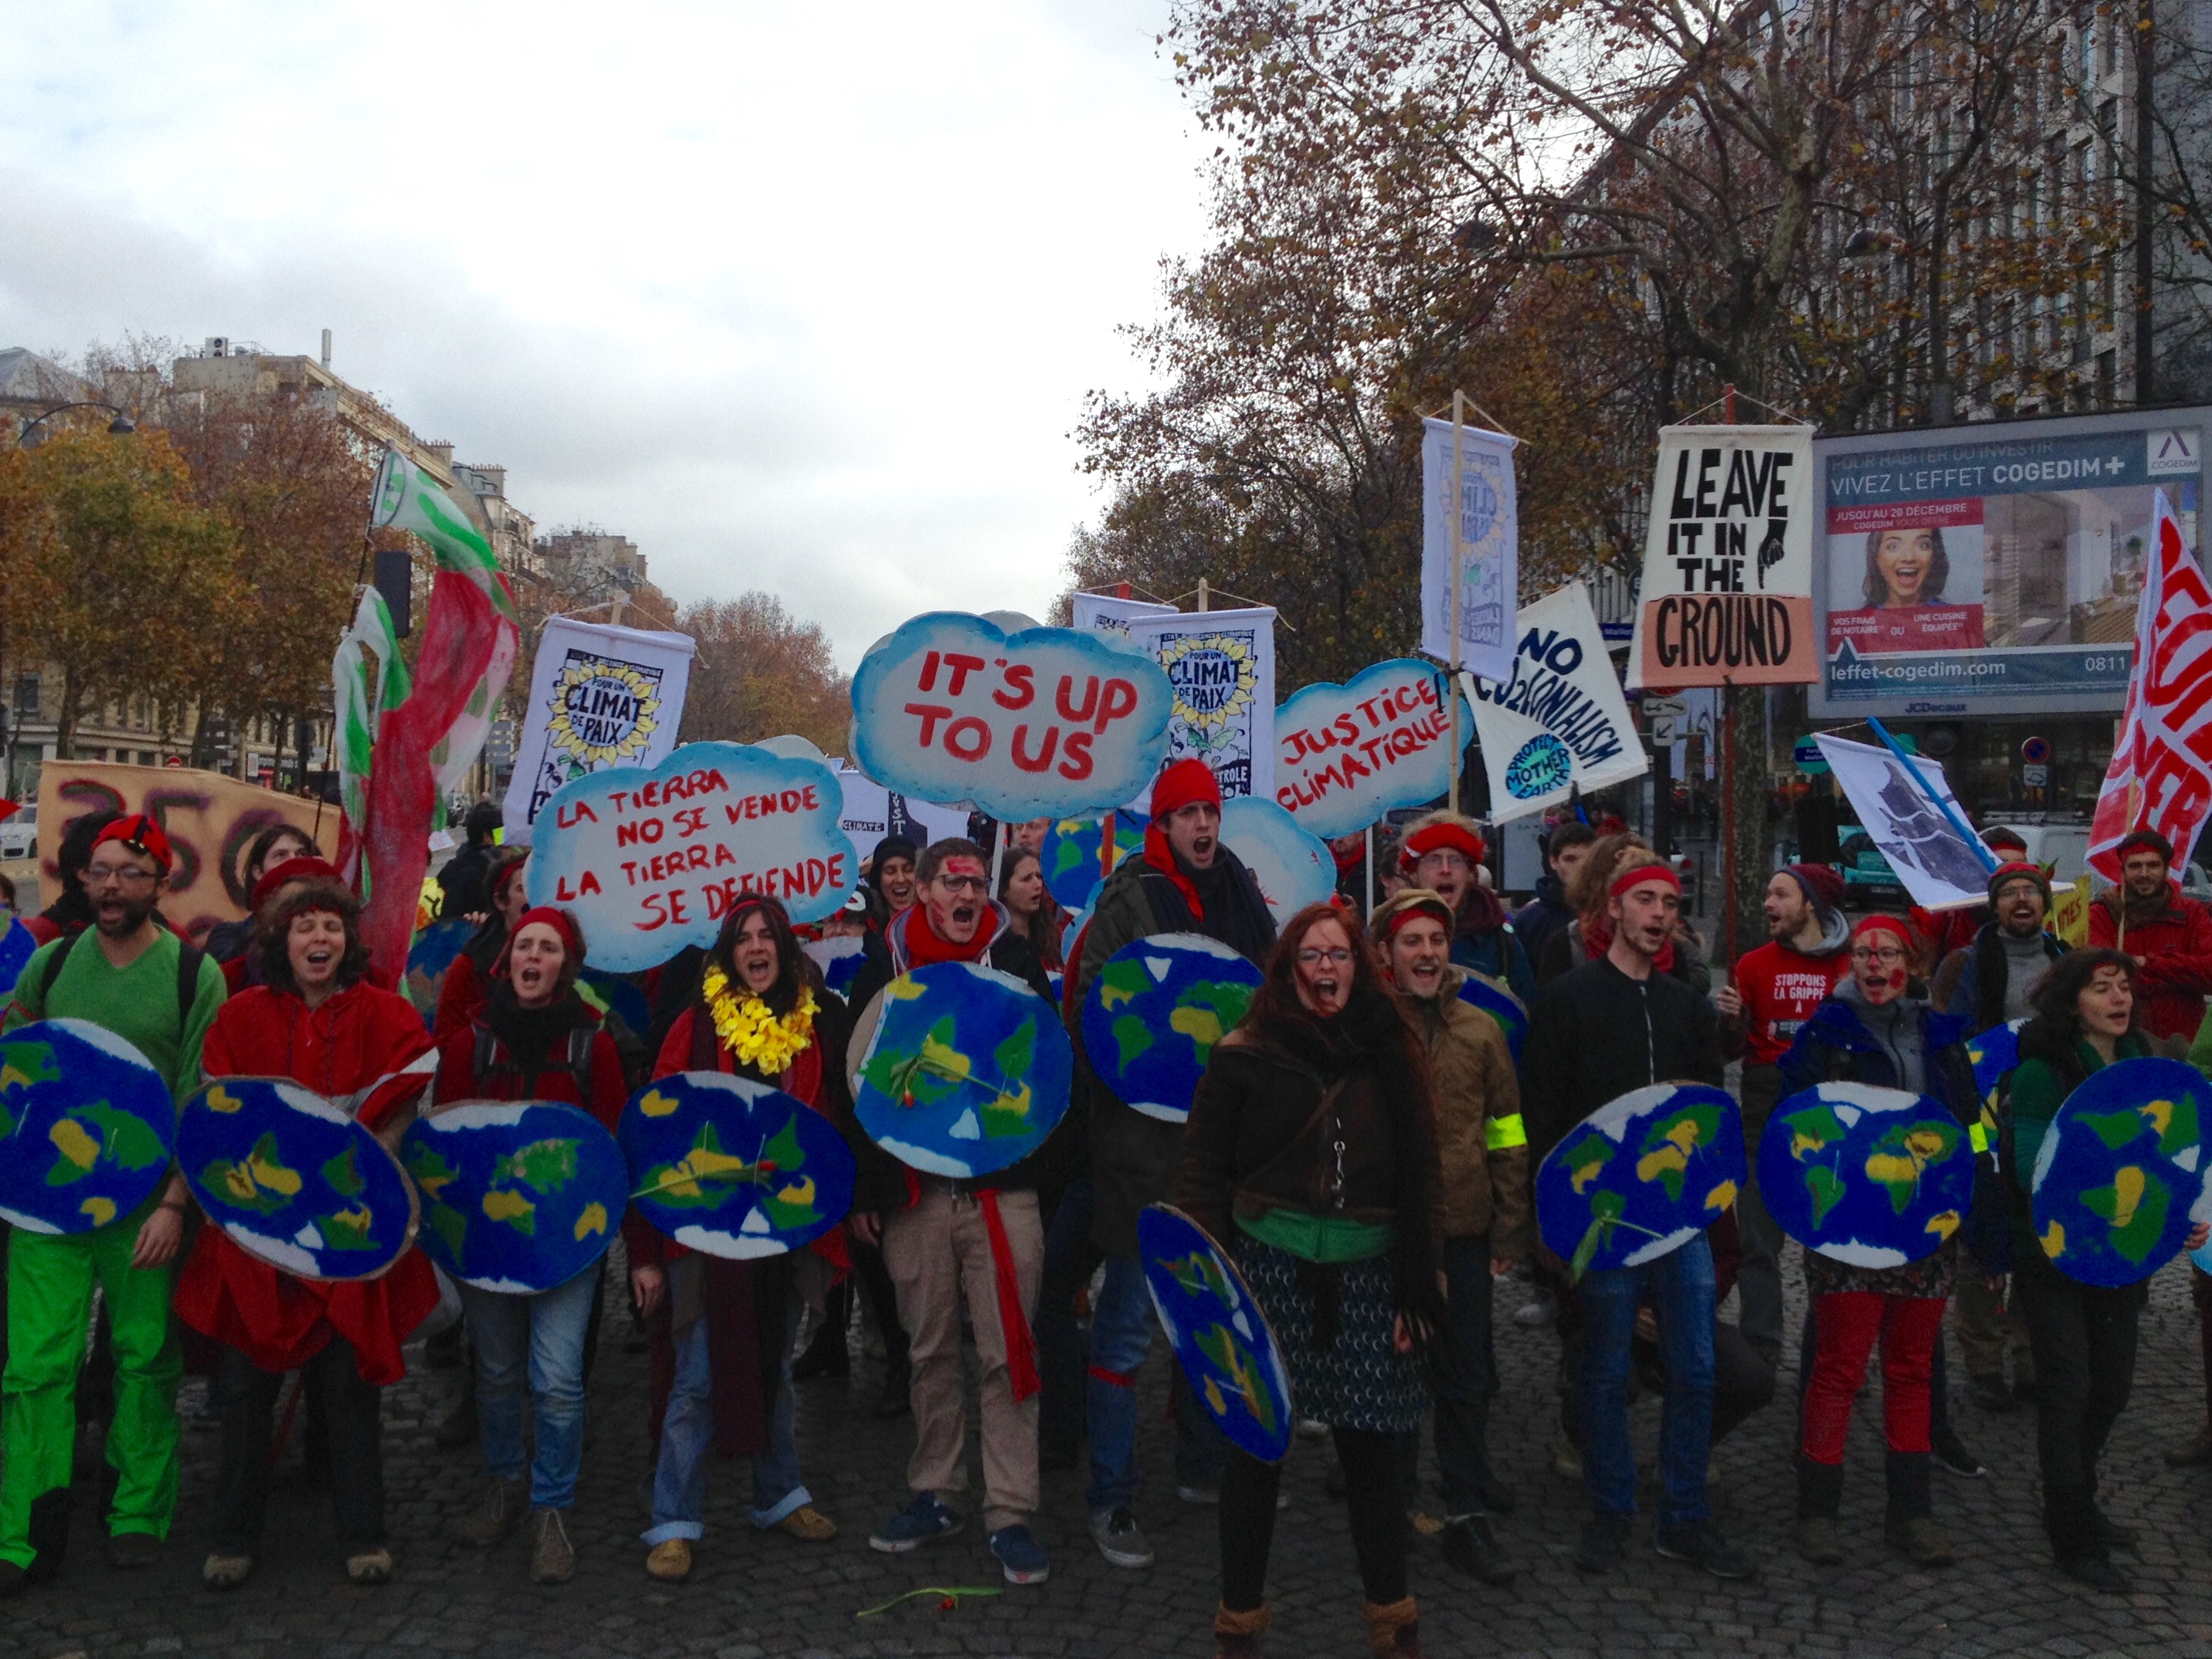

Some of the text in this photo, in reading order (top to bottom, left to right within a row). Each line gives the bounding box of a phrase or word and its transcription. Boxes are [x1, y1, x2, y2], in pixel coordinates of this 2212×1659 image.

[2152, 459, 2198, 470] COGEDIM
[1670, 449, 1793, 519] LEAVE
[1830, 474, 1891, 495] VIVEZ
[1900, 466, 1985, 490] L'EFFET
[1835, 510, 1888, 522] JUSQU'AU
[1906, 503, 1967, 517] DÉCEMBRE
[1854, 521, 1893, 530] COGEDIM
[1667, 523, 1746, 555] IT IN
[1677, 558, 1744, 592] THE
[1657, 597, 1791, 667] GROUND
[1890, 626, 1905, 636] OU
[1517, 628, 1583, 675] NO
[2085, 656, 2125, 671] 0811
[592, 677, 613, 689] POUR
[1168, 660, 1243, 685] CLIMAT
[1831, 662, 2006, 681] leffet-cogedim.com
[565, 684, 646, 723] CLIMAT
[918, 651, 1138, 735] IT'S UP
[1179, 687, 1225, 709] DE PAIX
[1905, 702, 1967, 714] JCDecaux
[572, 714, 623, 745] DE PAIX
[1281, 677, 1437, 765] JUSTICE
[904, 703, 1094, 781] TO US
[1277, 704, 1451, 813] CLIMATIQUE
[1506, 748, 1570, 790] MOTHER
[557, 801, 599, 830] LA
[608, 768, 729, 813] TIERRA
[1515, 768, 1570, 799] EARTH
[618, 785, 820, 847] NO SE VENDE
[843, 821, 884, 832] CLIMATE
[555, 843, 736, 901] LA TIERRA
[632, 889, 692, 931] SE
[1774, 987, 1786, 1000] LA
[1775, 974, 1827, 987] STOPPONS
[1795, 1000, 1802, 1013] A
